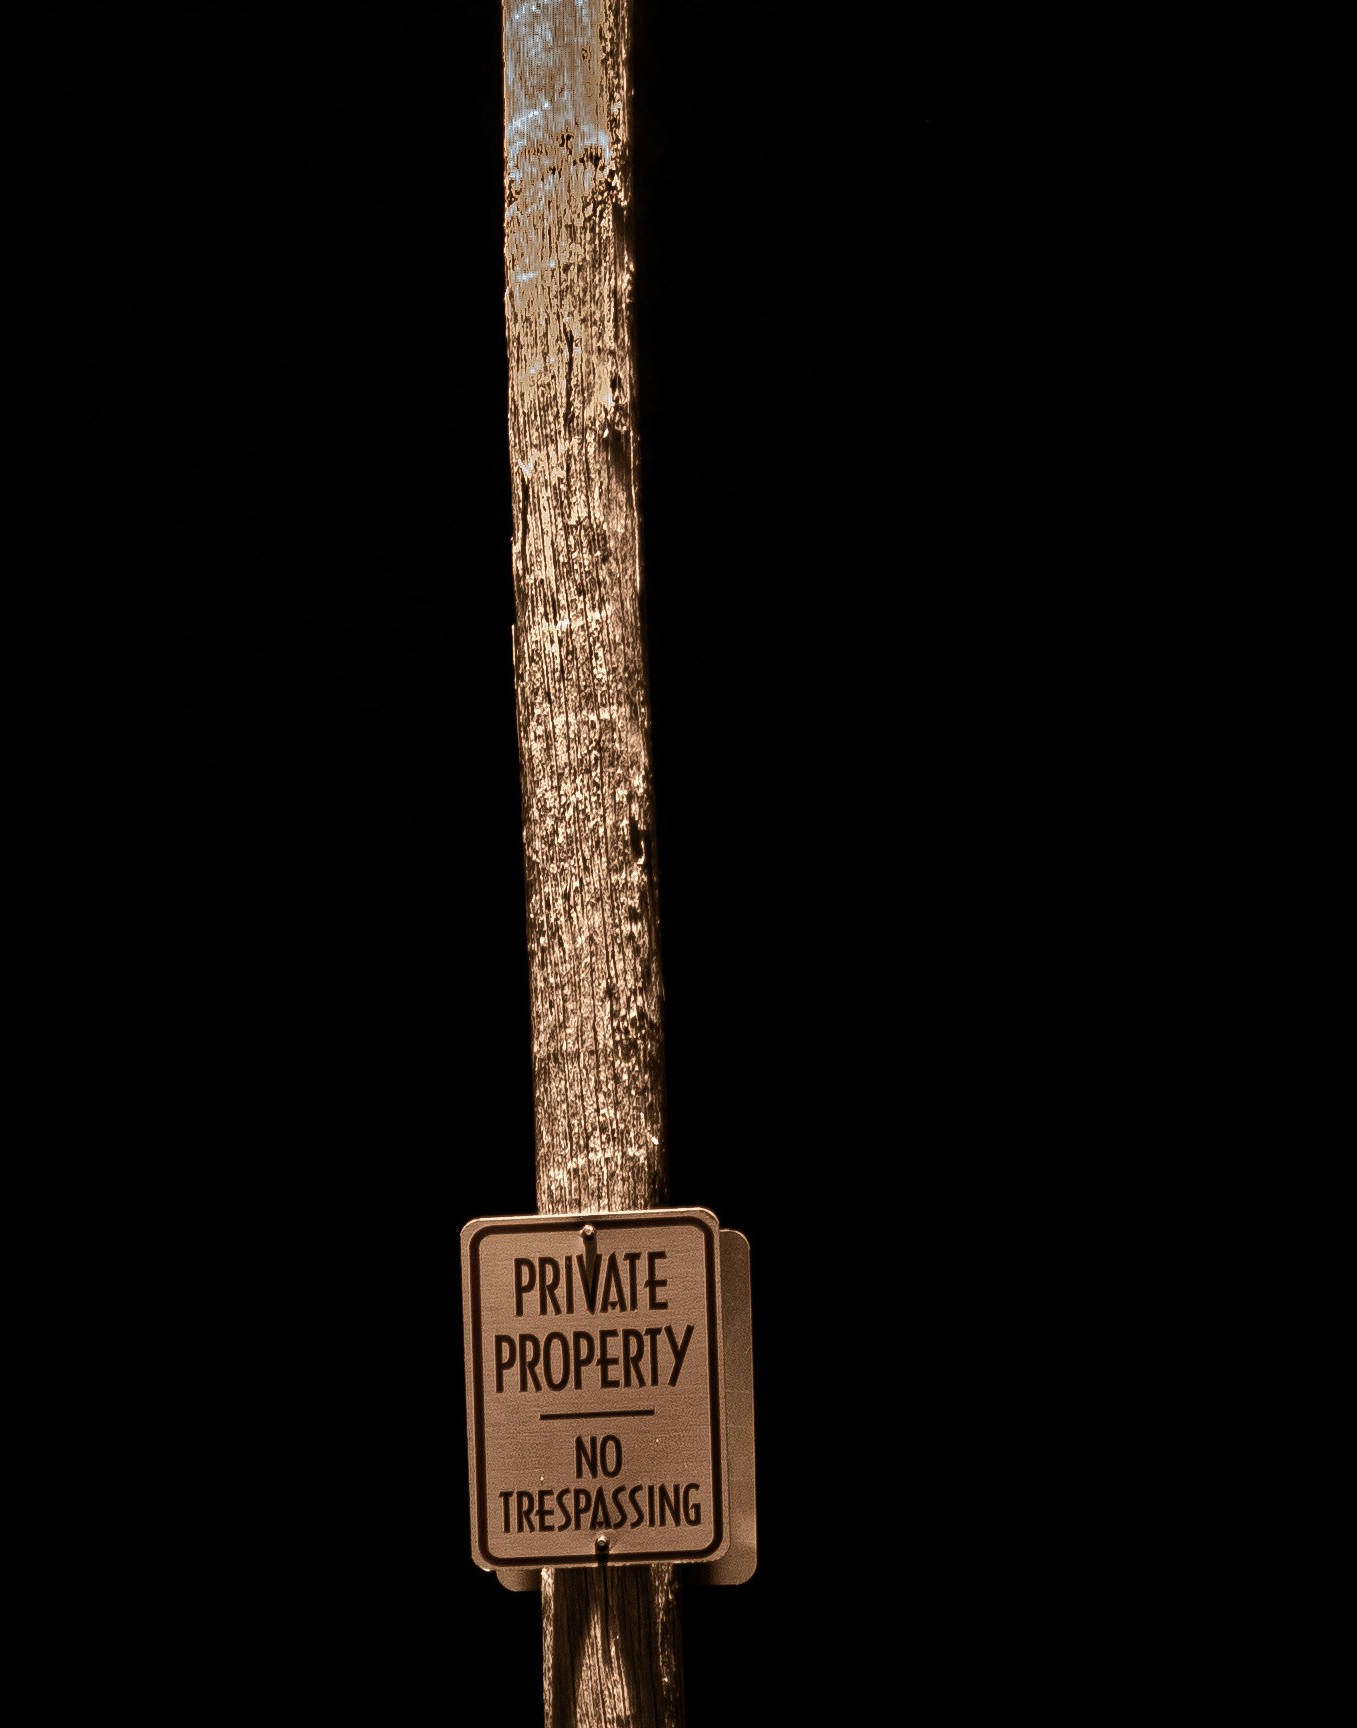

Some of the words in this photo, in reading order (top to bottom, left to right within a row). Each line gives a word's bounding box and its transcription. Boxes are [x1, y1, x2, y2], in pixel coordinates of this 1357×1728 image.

[513, 1250, 669, 1317] PRIVATE
[494, 1324, 695, 1394] PROPERTY
[574, 1434, 623, 1480] NO
[498, 1482, 702, 1534] TRESPASSING
